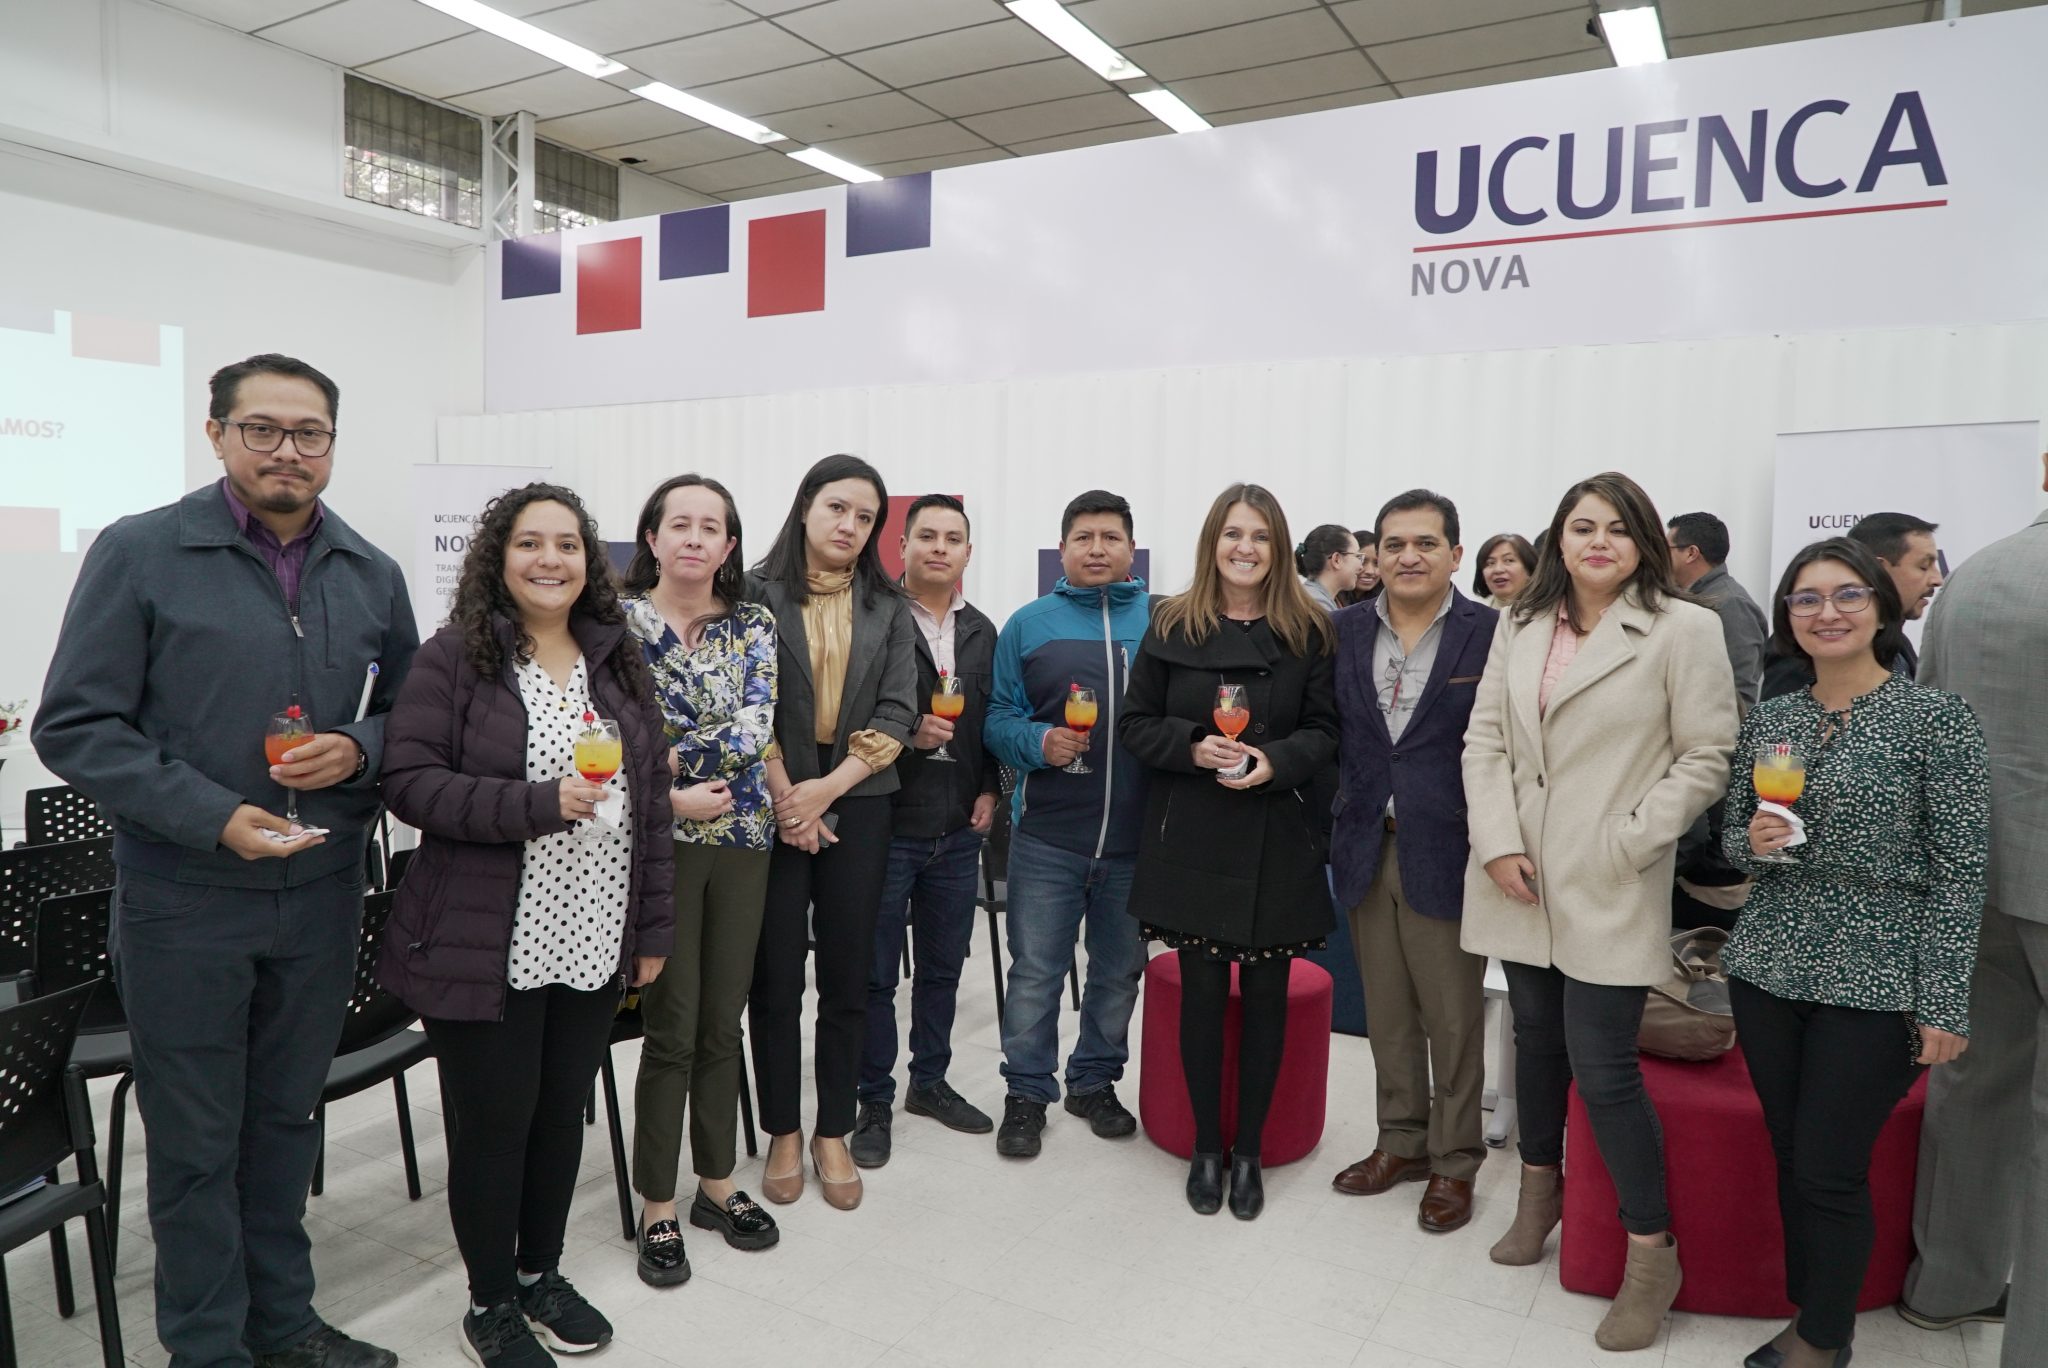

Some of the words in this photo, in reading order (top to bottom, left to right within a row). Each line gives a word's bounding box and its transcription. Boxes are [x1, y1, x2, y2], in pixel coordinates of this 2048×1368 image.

[1414, 90, 1949, 235] UCUENCA
[1410, 254, 1531, 297] NOVA
[0, 417, 65, 439] MOS?
[1809, 514, 1864, 529] UCUEN
